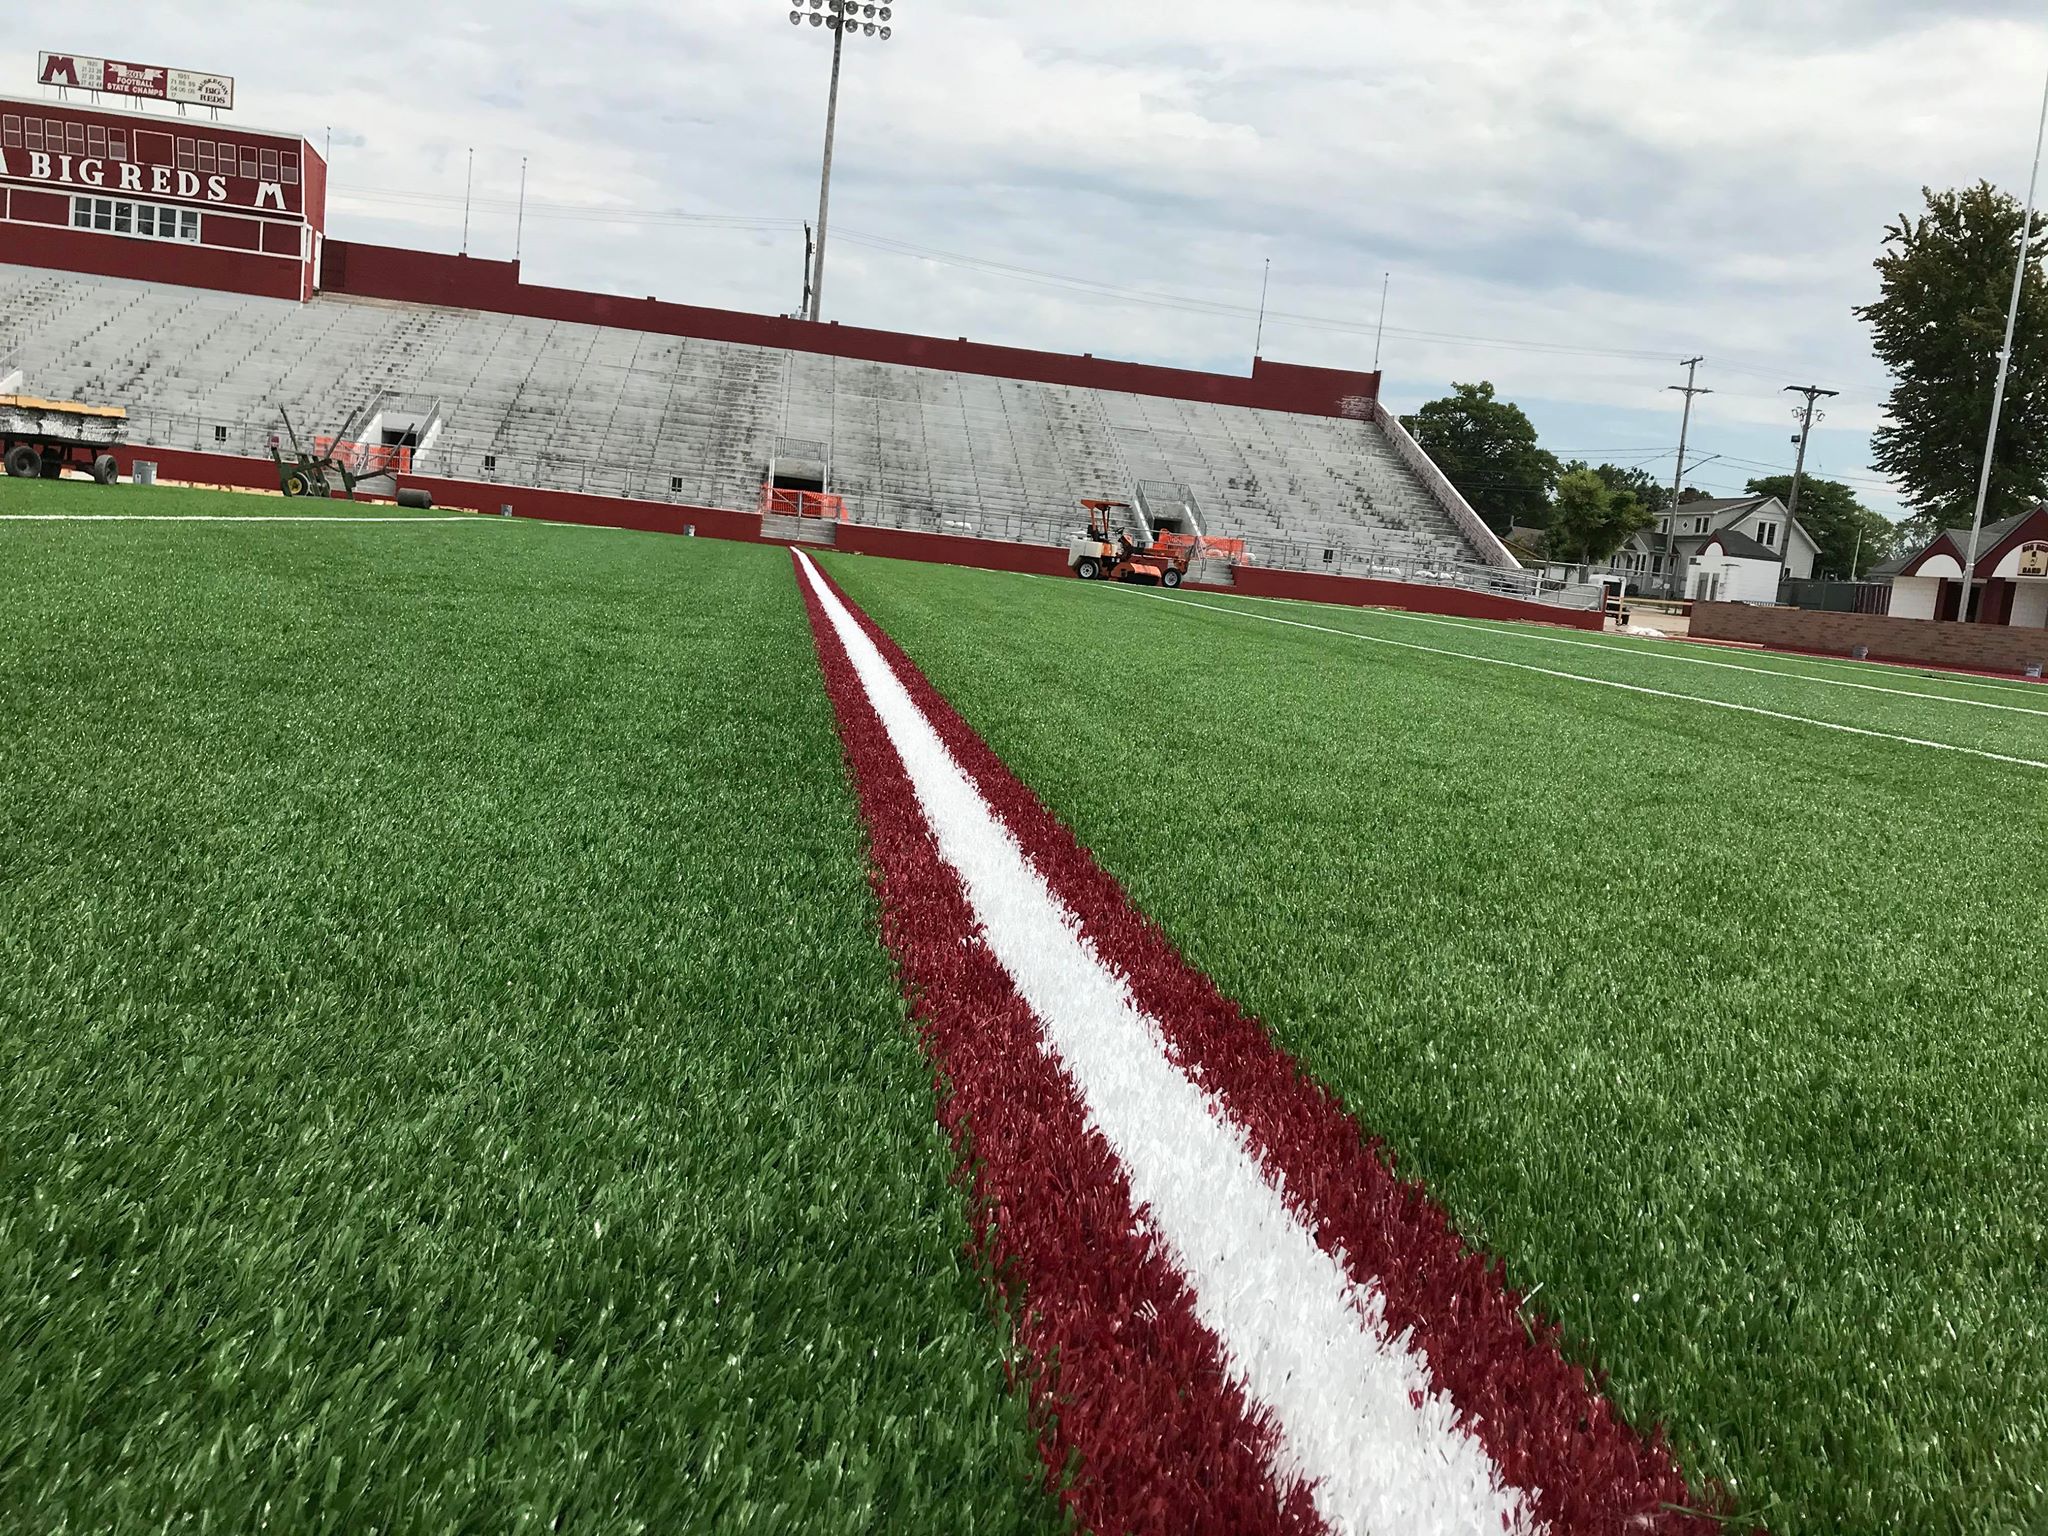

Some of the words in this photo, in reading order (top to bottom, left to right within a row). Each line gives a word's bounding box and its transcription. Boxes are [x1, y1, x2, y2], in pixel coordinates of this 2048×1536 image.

[41, 55, 80, 85] M
[126, 70, 146, 79] 2017
[117, 77, 154, 88] FOOTBALL
[107, 82, 130, 92] STATE
[132, 86, 164, 96] CHAMPS
[205, 87, 221, 95] BIG
[200, 94, 226, 104] REDS
[29, 151, 104, 186] BIG
[119, 163, 228, 201] REDS
[254, 181, 287, 210] M
